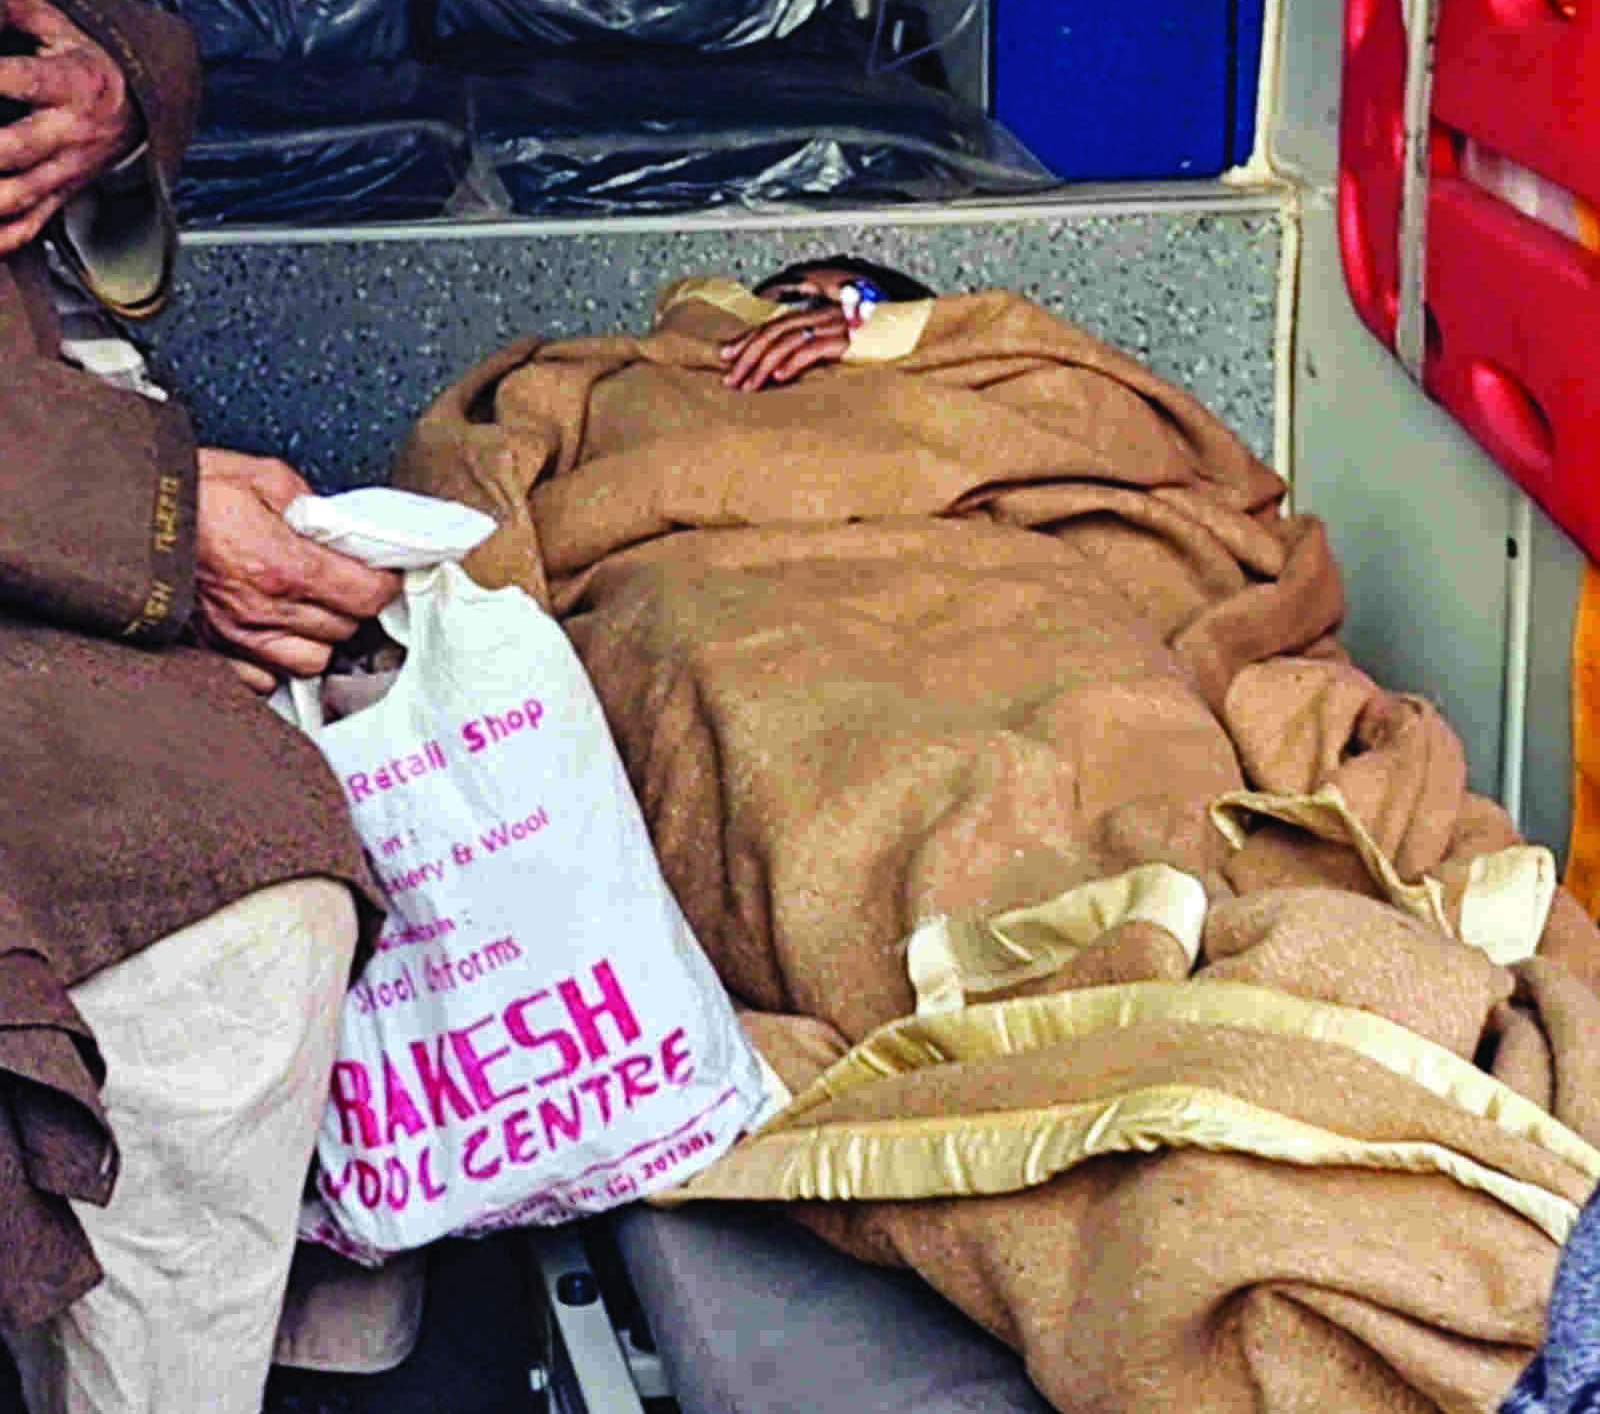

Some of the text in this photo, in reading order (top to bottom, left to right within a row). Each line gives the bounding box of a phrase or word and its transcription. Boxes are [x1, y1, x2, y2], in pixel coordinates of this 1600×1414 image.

[346, 698, 545, 804] Retail Shop
[451, 842, 473, 866] &
[479, 804, 549, 854] Wool
[330, 958, 641, 1149] RAKESH
[460, 1027, 697, 1181] CENTRE
